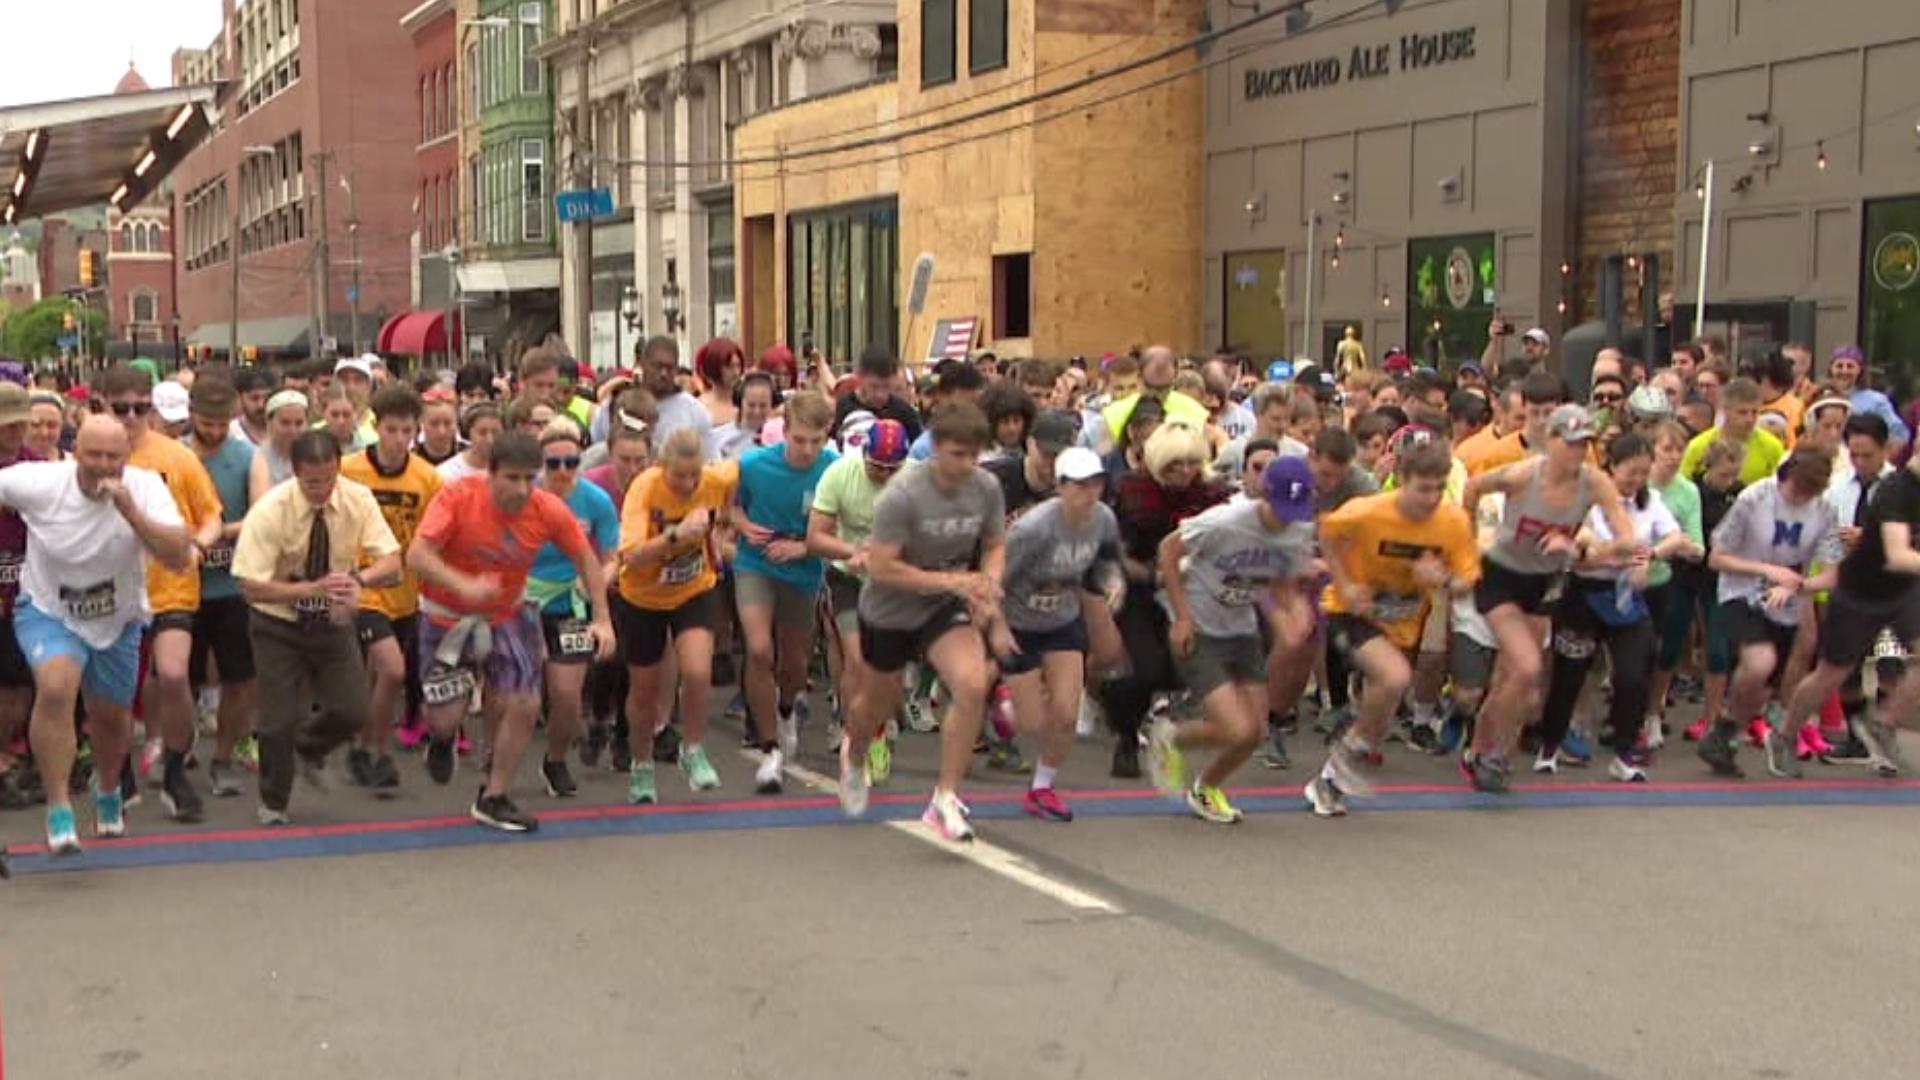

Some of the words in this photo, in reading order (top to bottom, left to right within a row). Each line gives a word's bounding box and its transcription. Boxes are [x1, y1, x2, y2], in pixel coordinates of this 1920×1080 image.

[1244, 56, 1340, 101] BACKYARD
[1349, 43, 1390, 81] ALE
[1400, 26, 1476, 72] HOUSE
[1772, 520, 1803, 547] M
